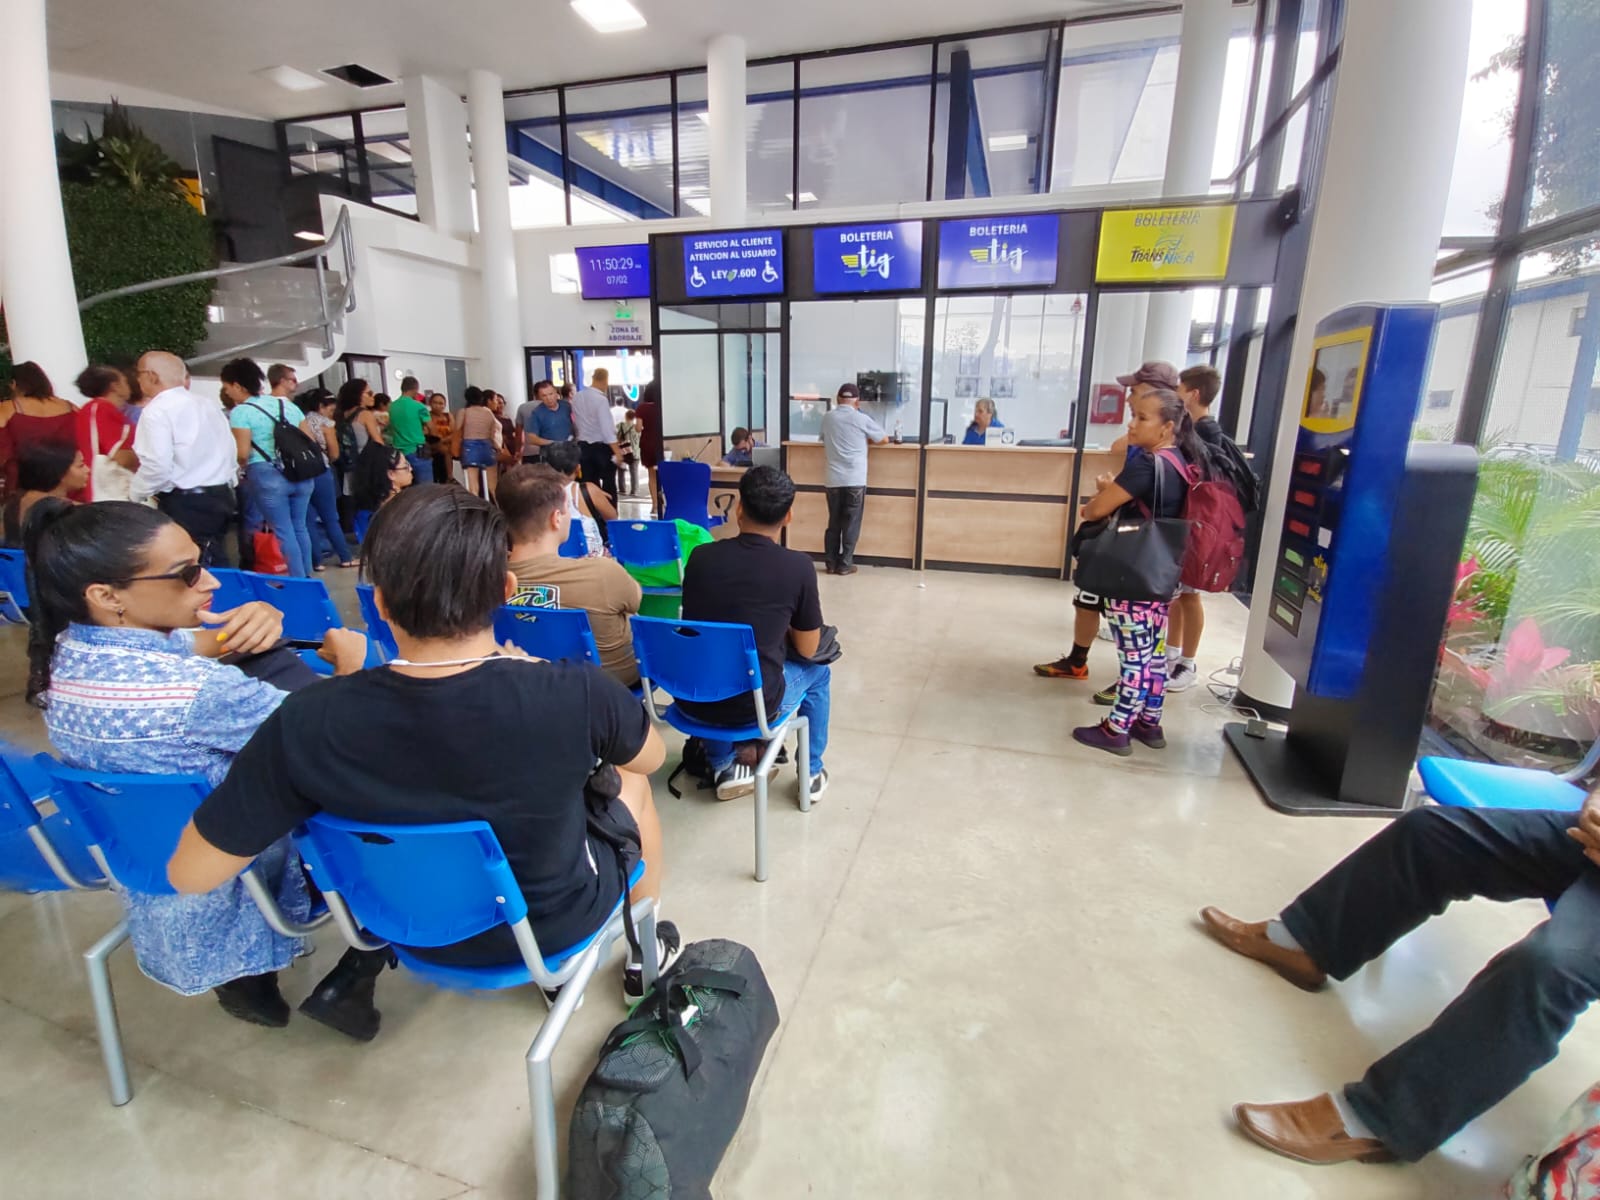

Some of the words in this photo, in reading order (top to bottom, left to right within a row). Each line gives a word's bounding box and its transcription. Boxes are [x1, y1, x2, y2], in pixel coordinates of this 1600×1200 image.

[1134, 211, 1200, 227] BOLETERIA
[840, 230, 893, 243] BOLETERIA
[969, 223, 1028, 237] BOLETERIA
[694, 240, 728, 250] SERVICIO
[730, 239, 740, 248] AL
[741, 236, 773, 247] CLIENTE
[689, 252, 728, 262] ATENCION
[730, 251, 740, 259] AL
[741, 248, 777, 259] USUARIO
[857, 244, 895, 279] tig
[988, 238, 1028, 273] tig
[590, 257, 633, 271] 11:50:29
[606, 274, 628, 285] 07/02
[711, 270, 728, 280] LEY
